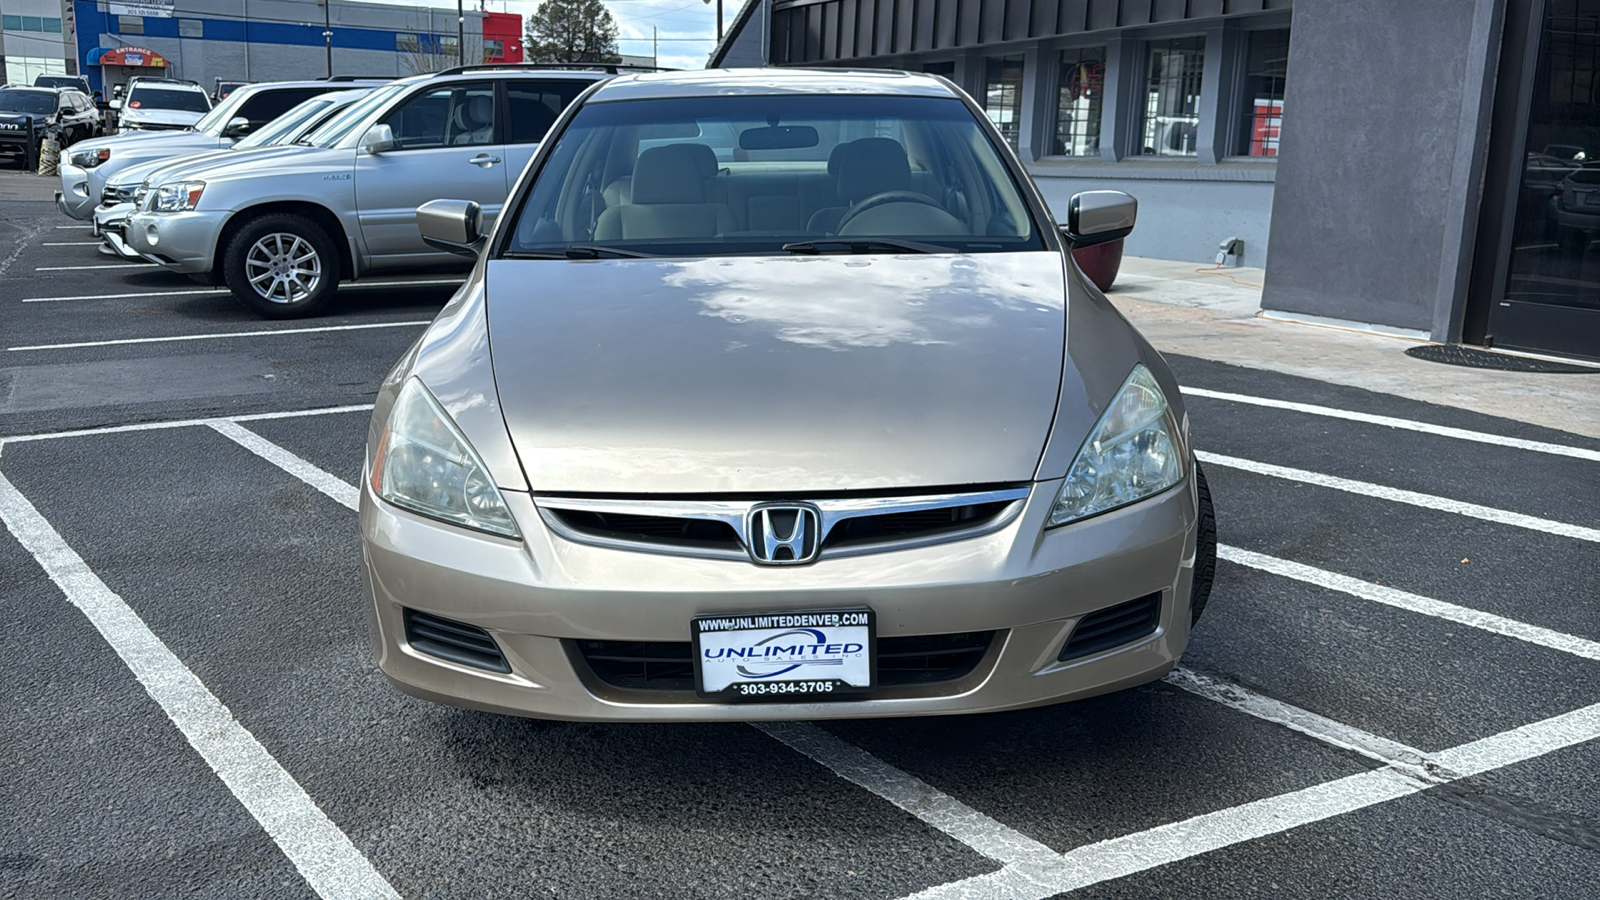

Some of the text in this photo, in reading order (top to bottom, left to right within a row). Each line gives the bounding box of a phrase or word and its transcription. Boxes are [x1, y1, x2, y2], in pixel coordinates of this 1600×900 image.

[115, 47, 152, 56] ENTRANCE
[699, 613, 868, 631] WWWUNLIMITEDDENVER.COM
[704, 643, 863, 659] UNLIMITED
[740, 681, 834, 695] 303-934-3705
